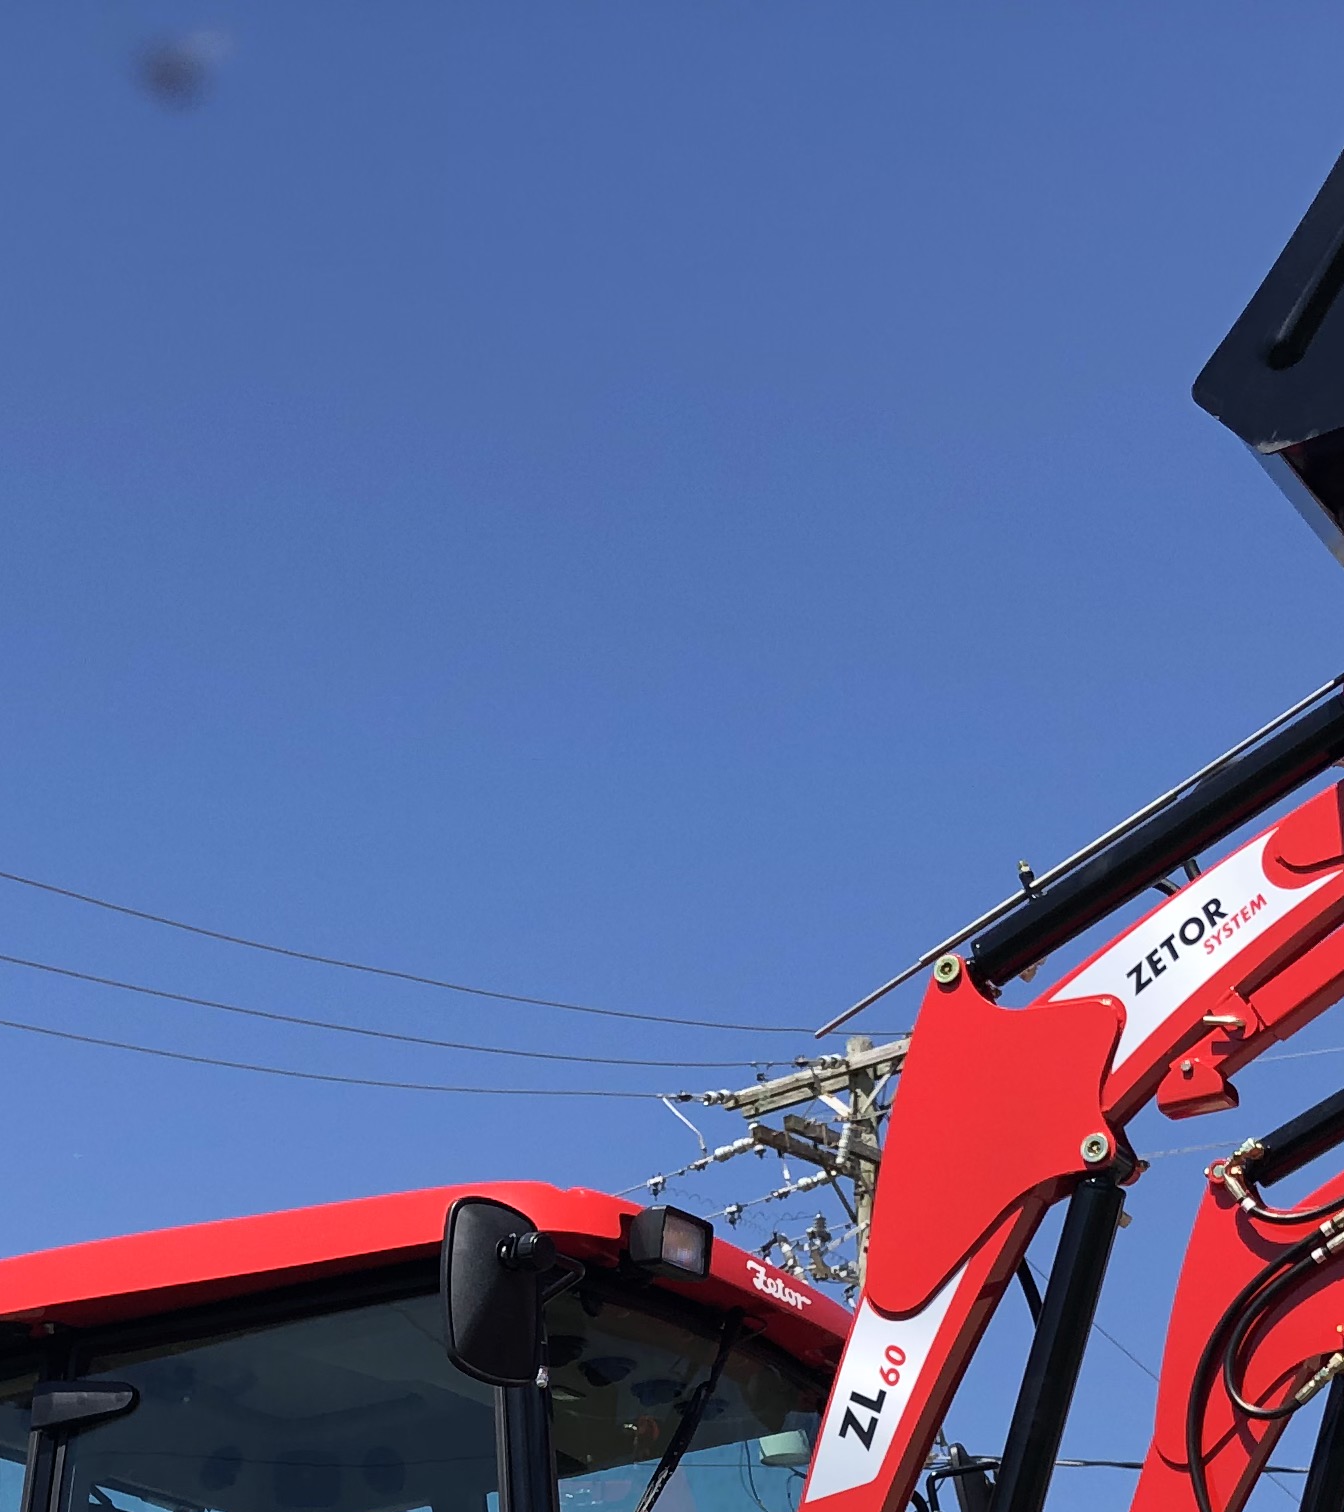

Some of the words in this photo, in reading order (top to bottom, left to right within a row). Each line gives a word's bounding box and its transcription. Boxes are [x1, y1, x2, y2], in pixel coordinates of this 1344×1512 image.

[1125, 897, 1229, 997] ZETOR
[1203, 892, 1269, 956] SYSTEM
[745, 1259, 812, 1311] Zetor
